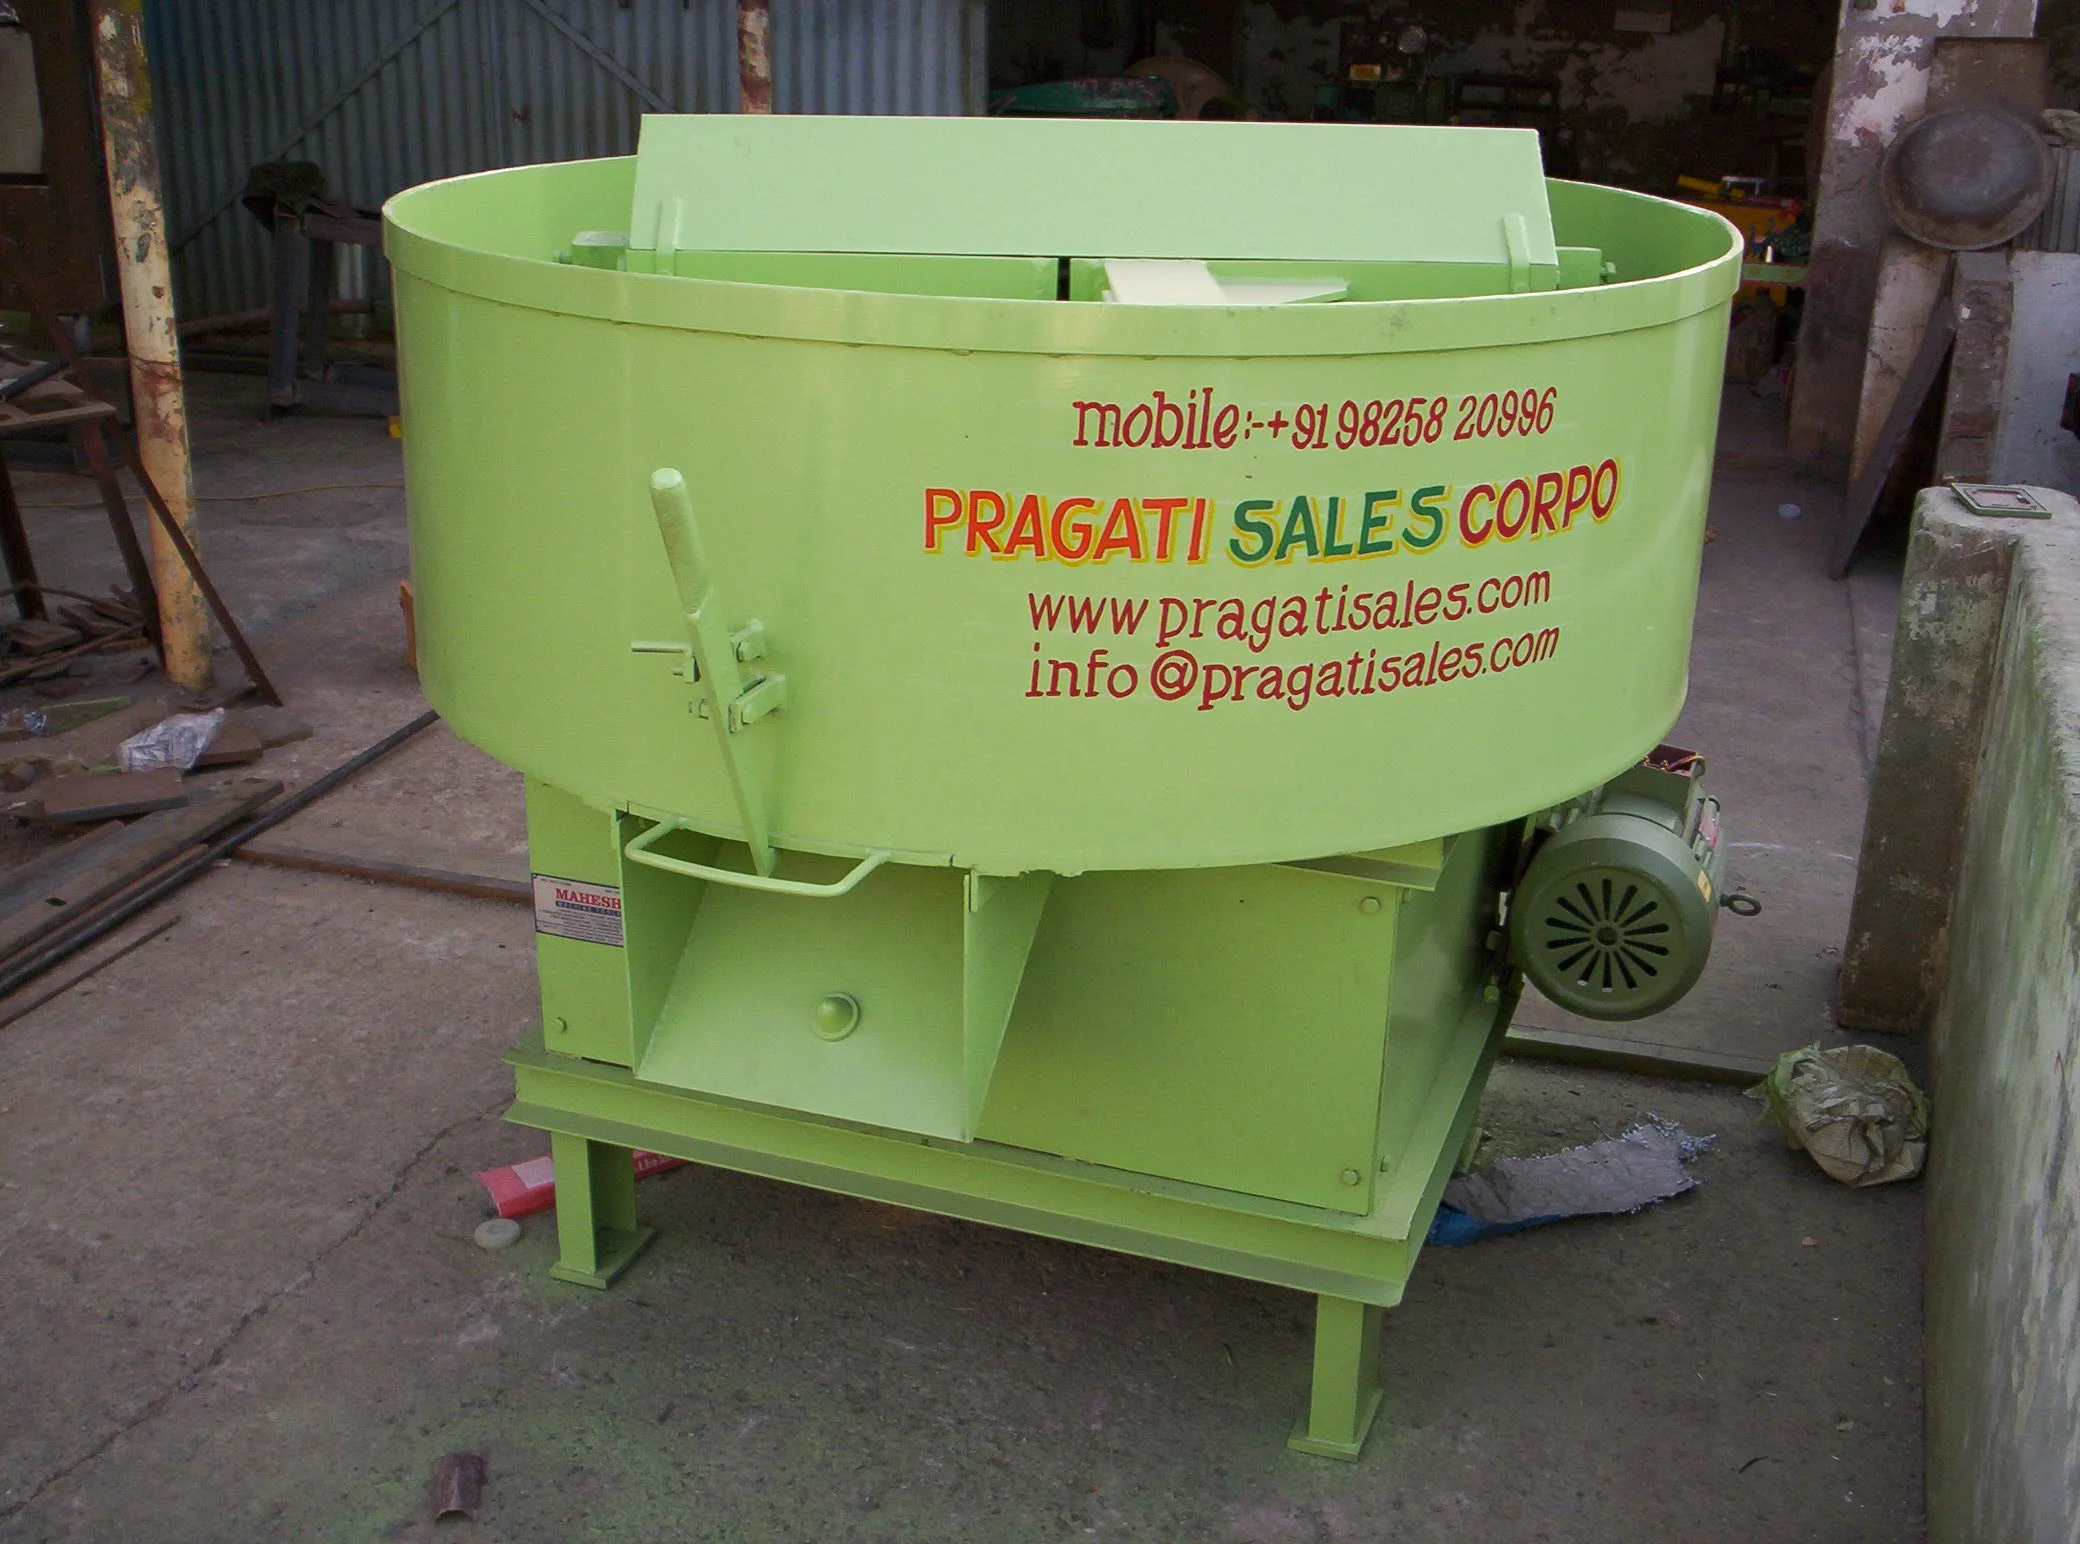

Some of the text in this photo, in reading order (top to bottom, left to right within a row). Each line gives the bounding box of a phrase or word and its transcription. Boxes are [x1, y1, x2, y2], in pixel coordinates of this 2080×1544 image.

[1451, 386, 1558, 441] 20996
[922, 457, 1622, 568] PRAGATI SALES CORPO
[555, 887, 622, 910] MAHESH
